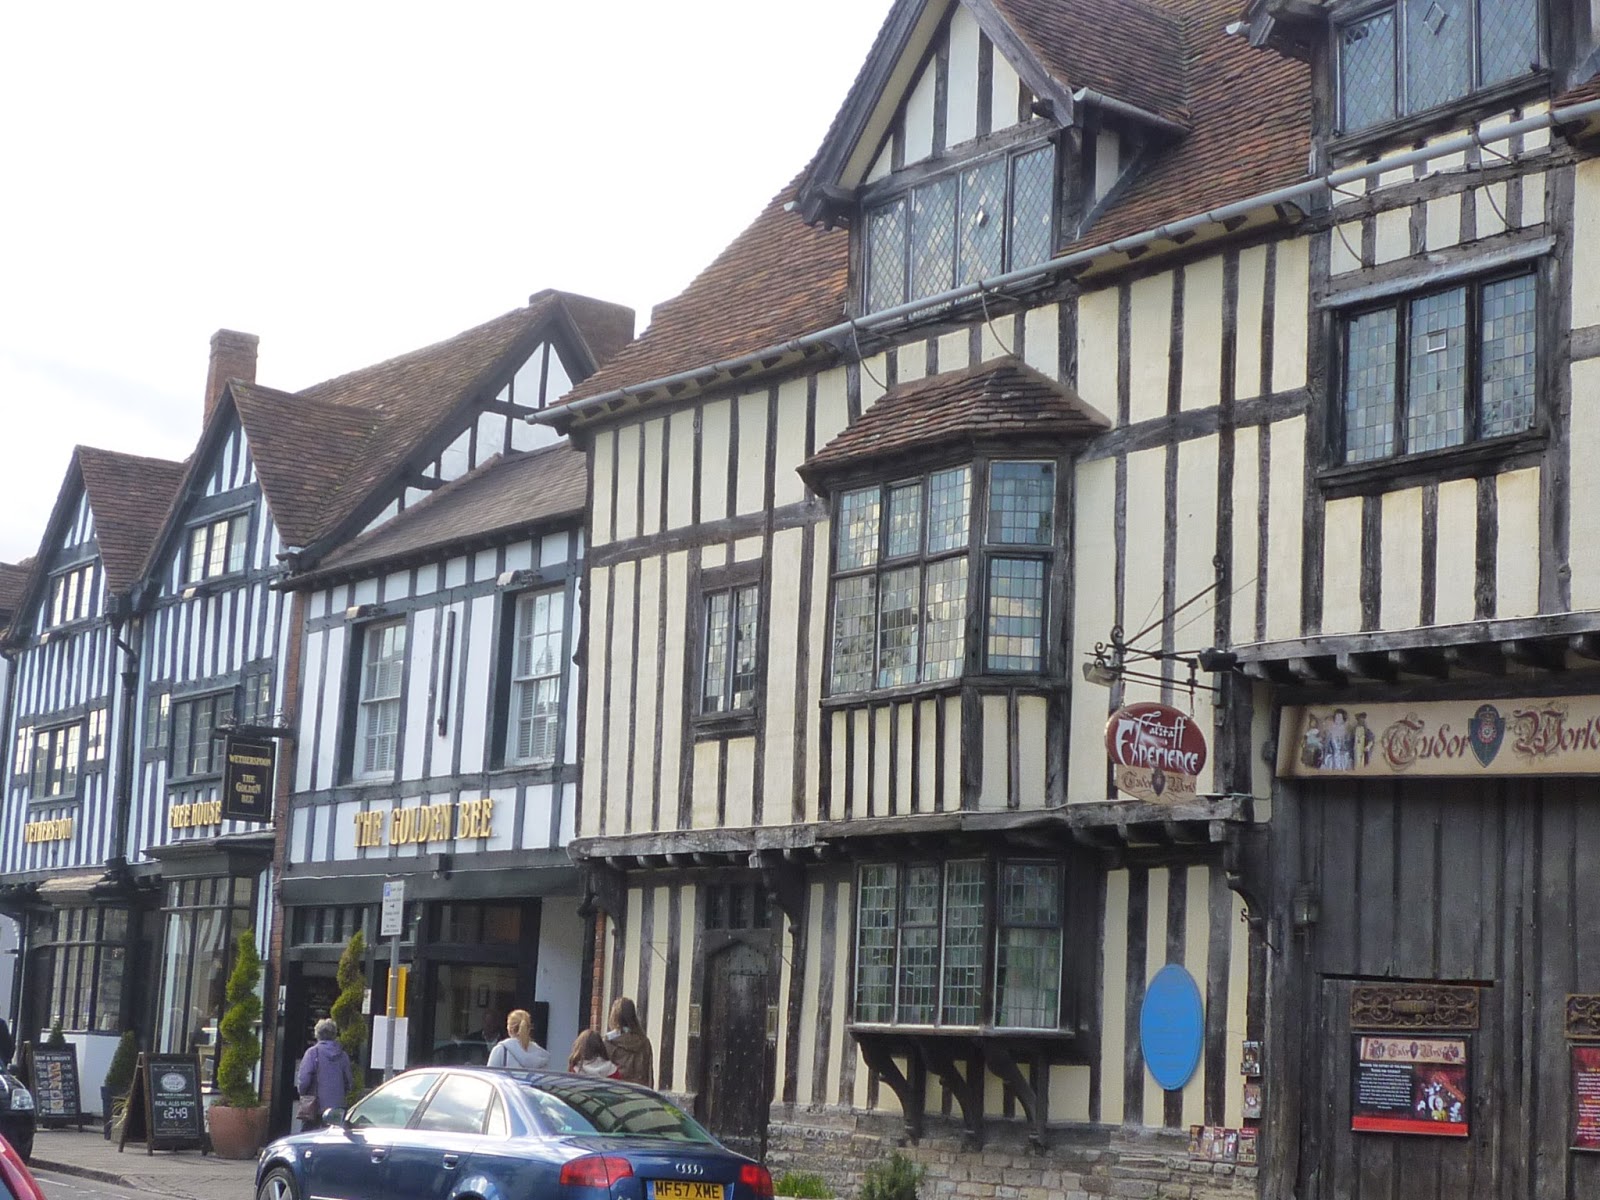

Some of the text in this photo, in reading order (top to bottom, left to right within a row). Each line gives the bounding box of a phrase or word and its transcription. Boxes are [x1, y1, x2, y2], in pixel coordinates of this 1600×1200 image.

[1383, 712, 1470, 771] Tudor
[242, 774, 256, 783] THE
[170, 800, 222, 828] FREE HOUSE
[354, 798, 494, 847] THE GOLDEN BEE
[655, 1181, 720, 1199] MF57 XME
